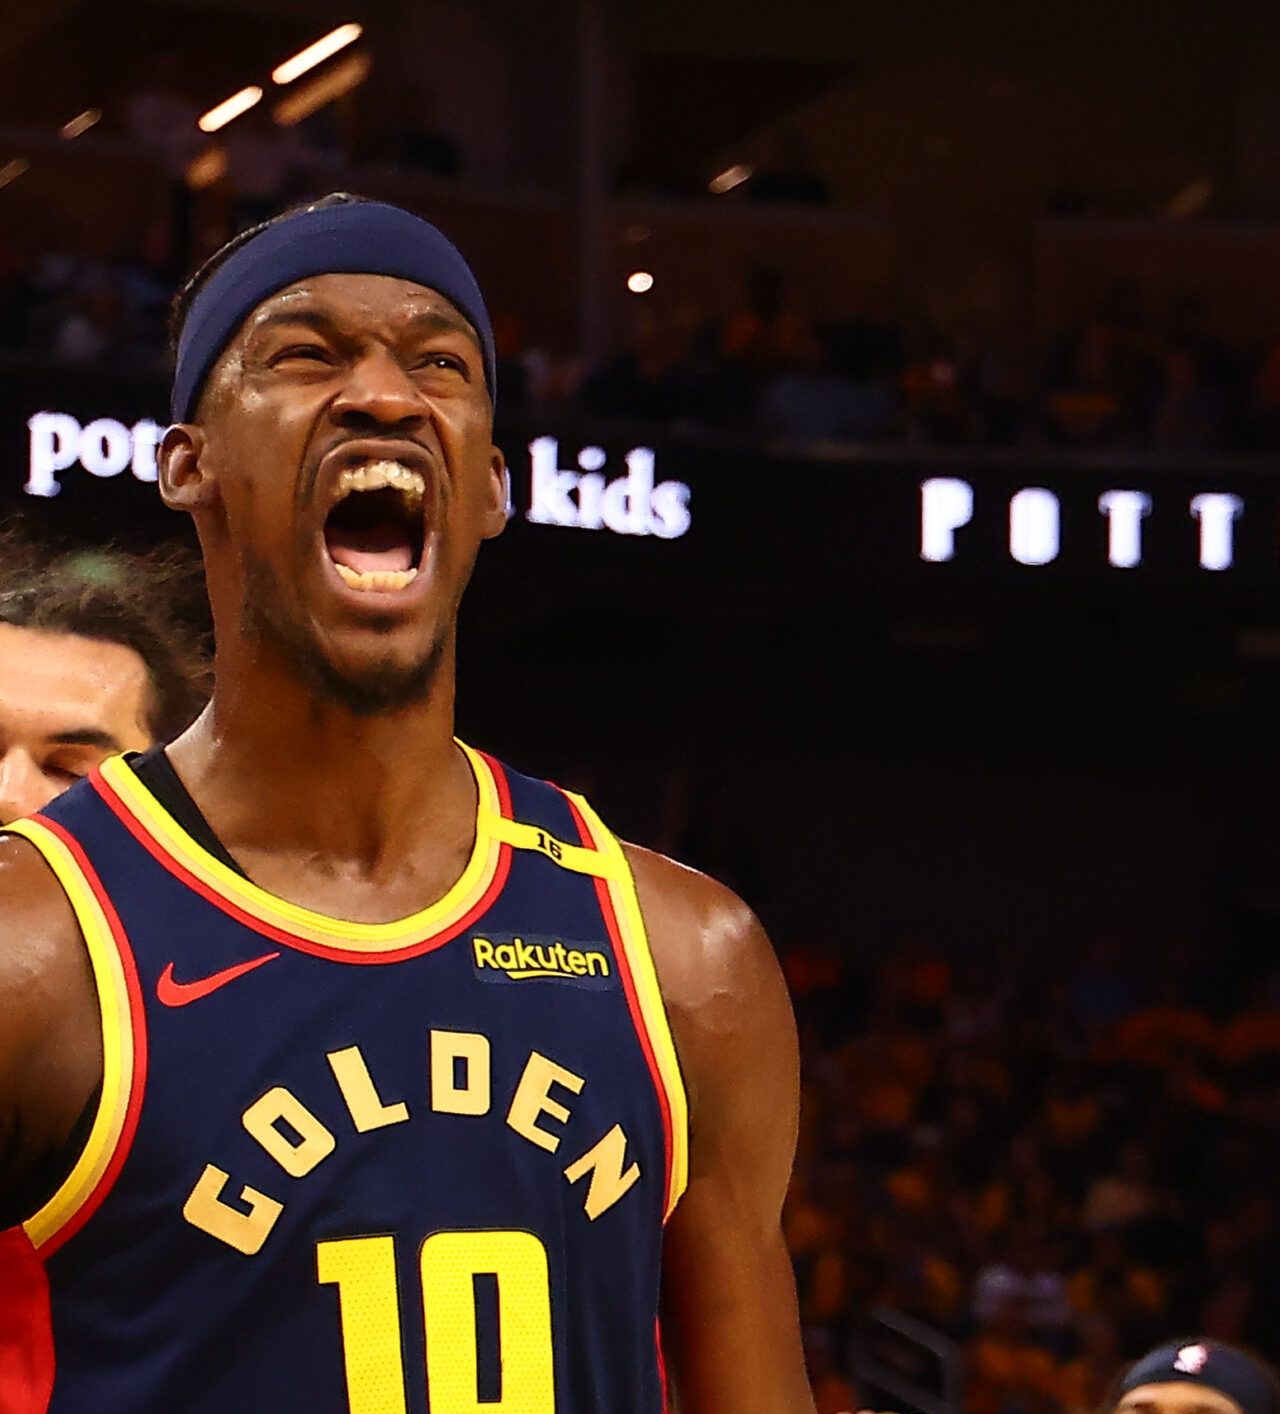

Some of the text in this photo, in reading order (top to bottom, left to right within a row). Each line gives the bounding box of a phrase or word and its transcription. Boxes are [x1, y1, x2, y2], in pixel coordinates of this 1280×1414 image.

[528, 438, 690, 538] kids
[473, 938, 610, 978] Rakuten
[182, 1029, 641, 1255] GOLDEN
